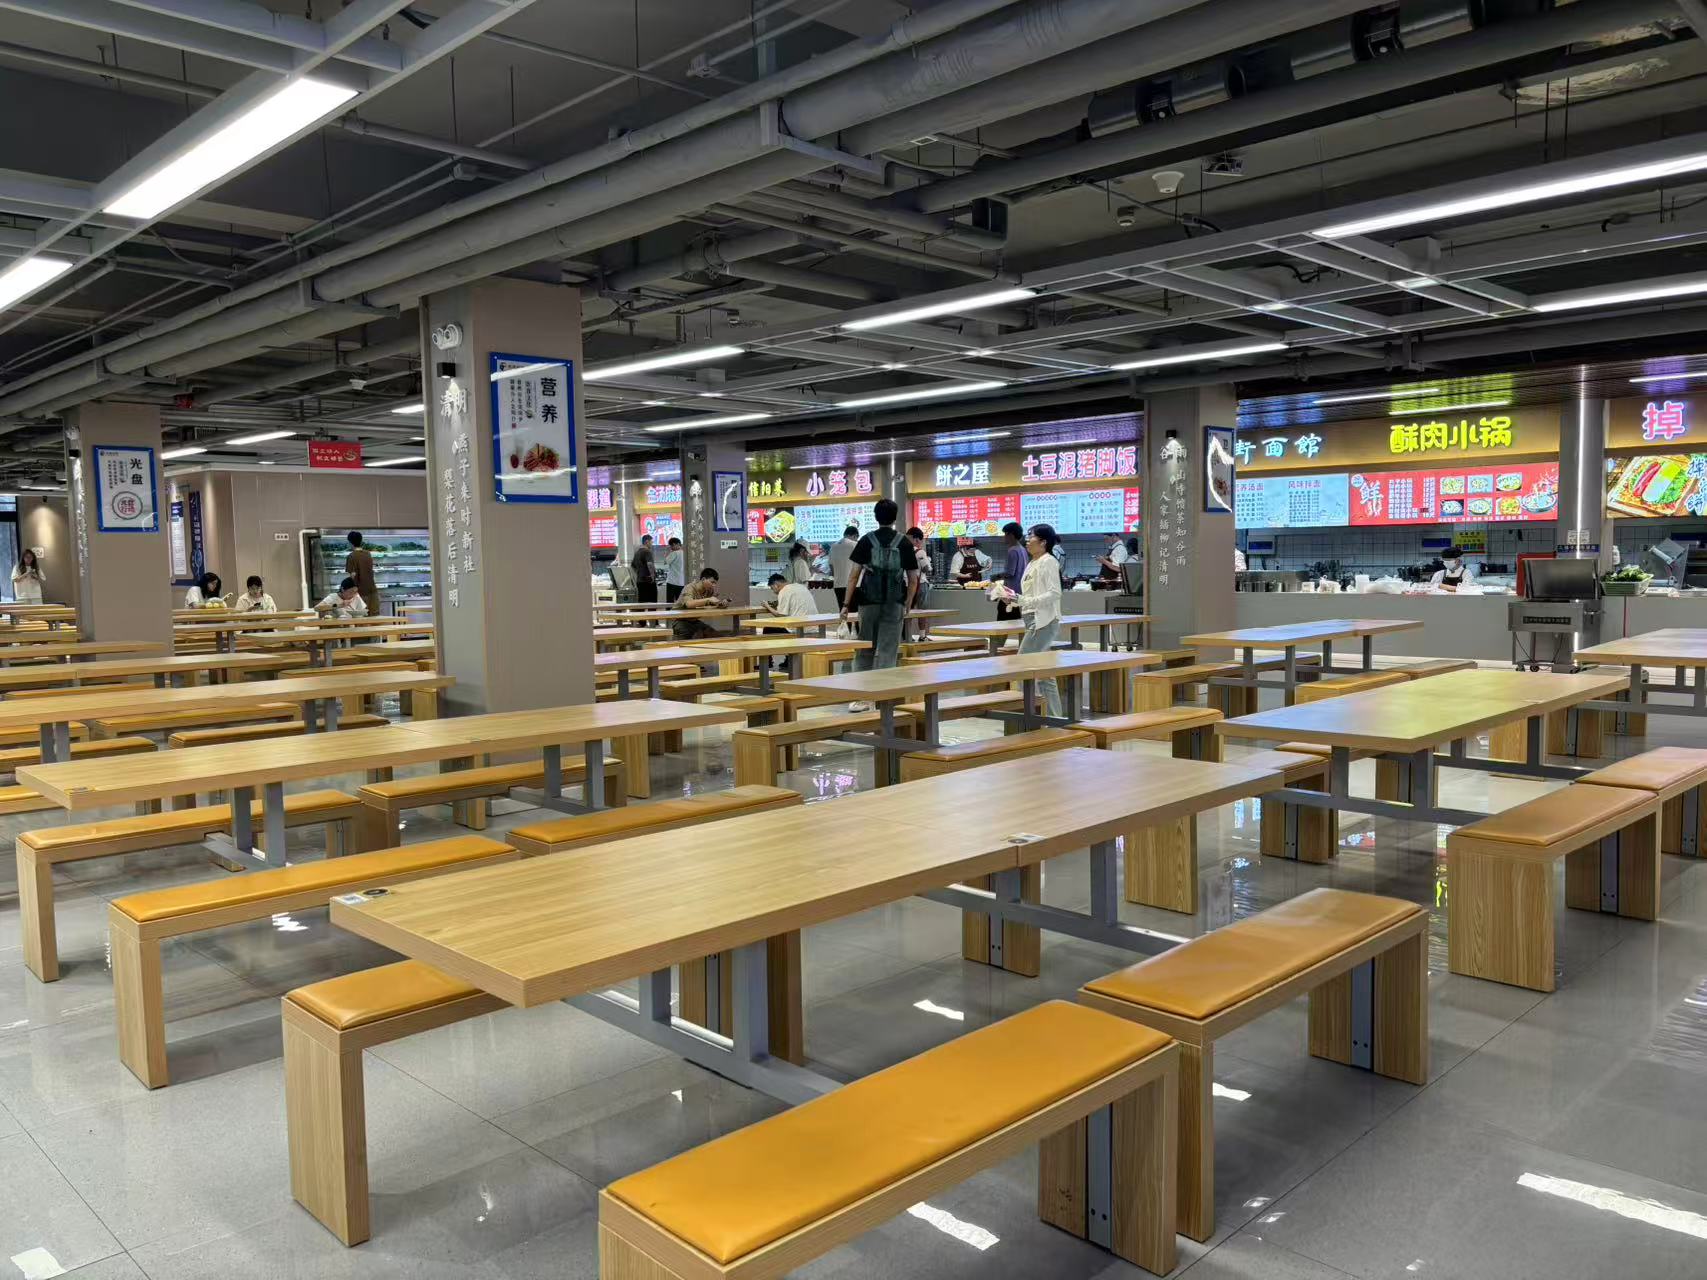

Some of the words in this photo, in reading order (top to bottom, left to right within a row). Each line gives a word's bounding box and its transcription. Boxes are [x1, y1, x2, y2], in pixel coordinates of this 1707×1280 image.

[440, 388, 468, 418] 清明
[541, 377, 558, 423] 营养
[1389, 416, 1512, 454] 酥肉小锅
[1642, 401, 1685, 440] 掉
[130, 458, 143, 485] 光盘
[1022, 446, 1136, 482] 土豆泥猪脚饭
[806, 468, 873, 497] 小笼包
